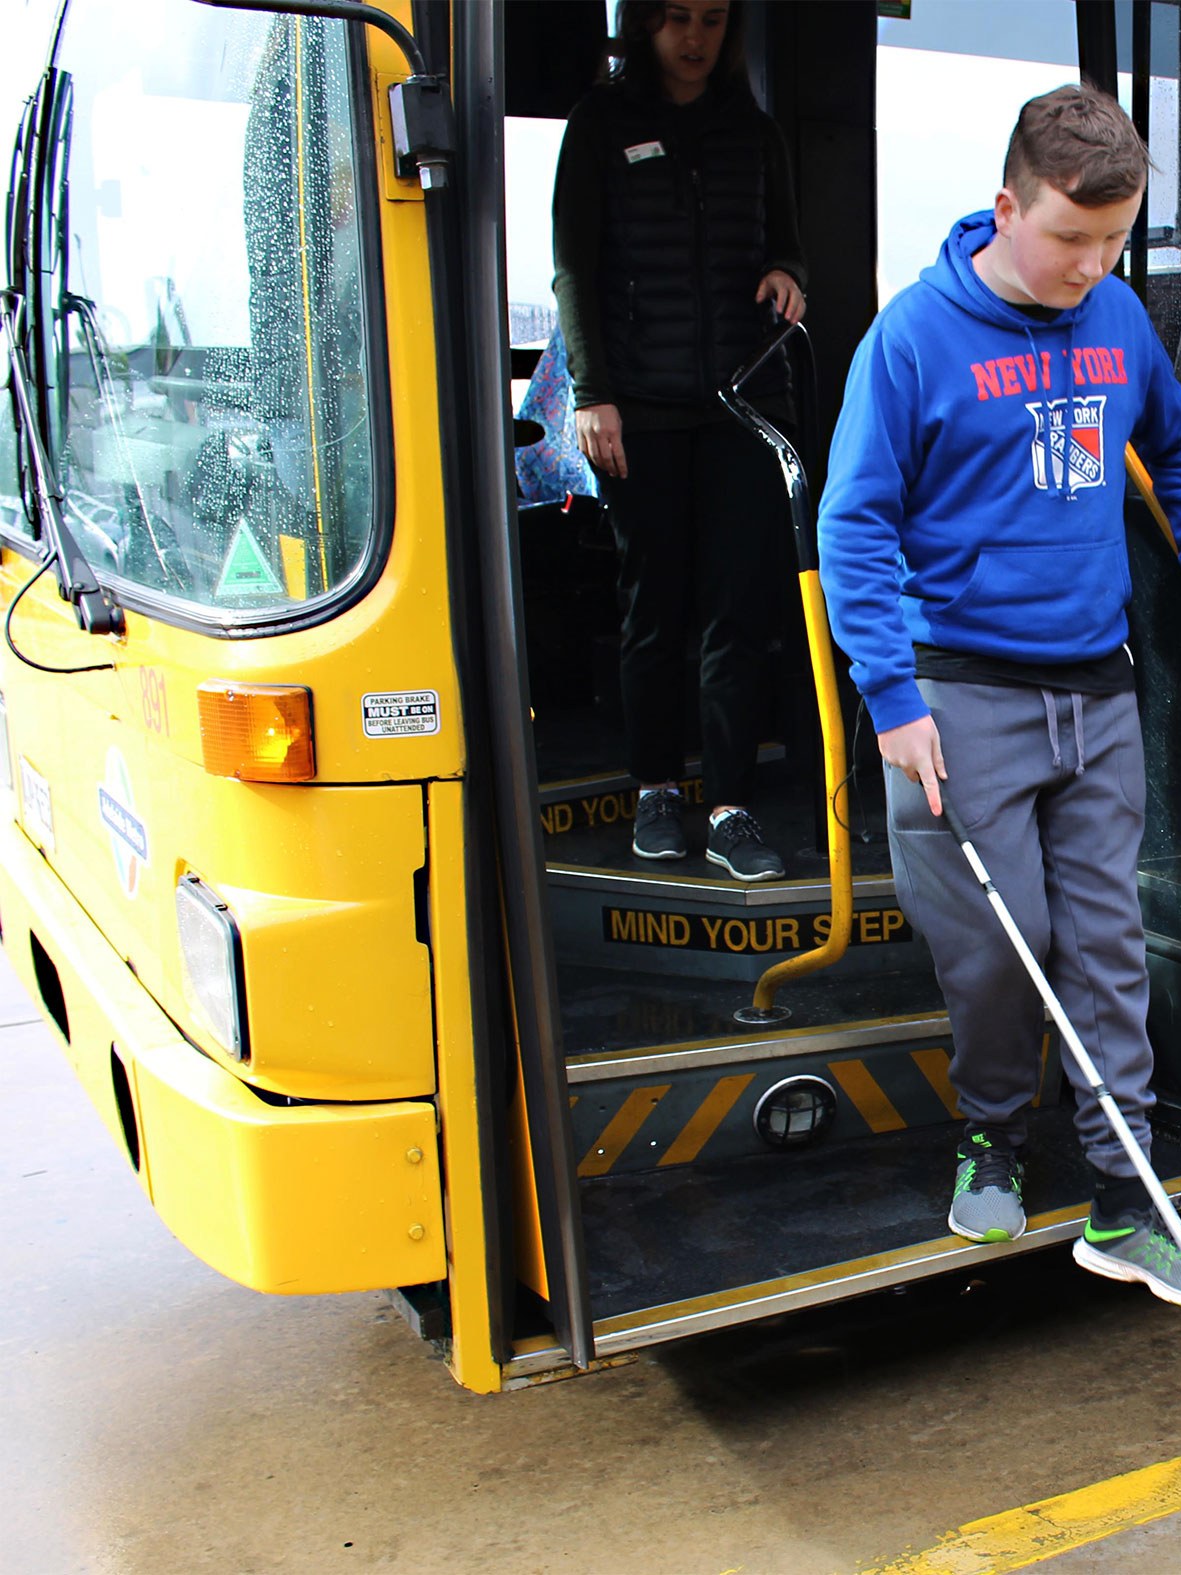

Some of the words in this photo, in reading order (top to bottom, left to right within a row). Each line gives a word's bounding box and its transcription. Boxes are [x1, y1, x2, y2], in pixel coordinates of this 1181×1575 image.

[1065, 407, 1099, 425] ORK
[1050, 431, 1099, 479] RAGERS
[139, 663, 170, 738] 891
[370, 697, 404, 705] PARKING
[405, 695, 430, 703] BRAKE
[368, 706, 409, 717] MUST
[422, 705, 434, 713] ON
[368, 719, 392, 727] BEFORE
[421, 716, 434, 724] BUS
[382, 724, 425, 733] UNATTENDED
[540, 803, 573, 834] ND
[582, 789, 637, 827] YOU
[610, 910, 691, 946] MIND
[701, 917, 800, 951] YOUR
[813, 909, 905, 943] SEP
